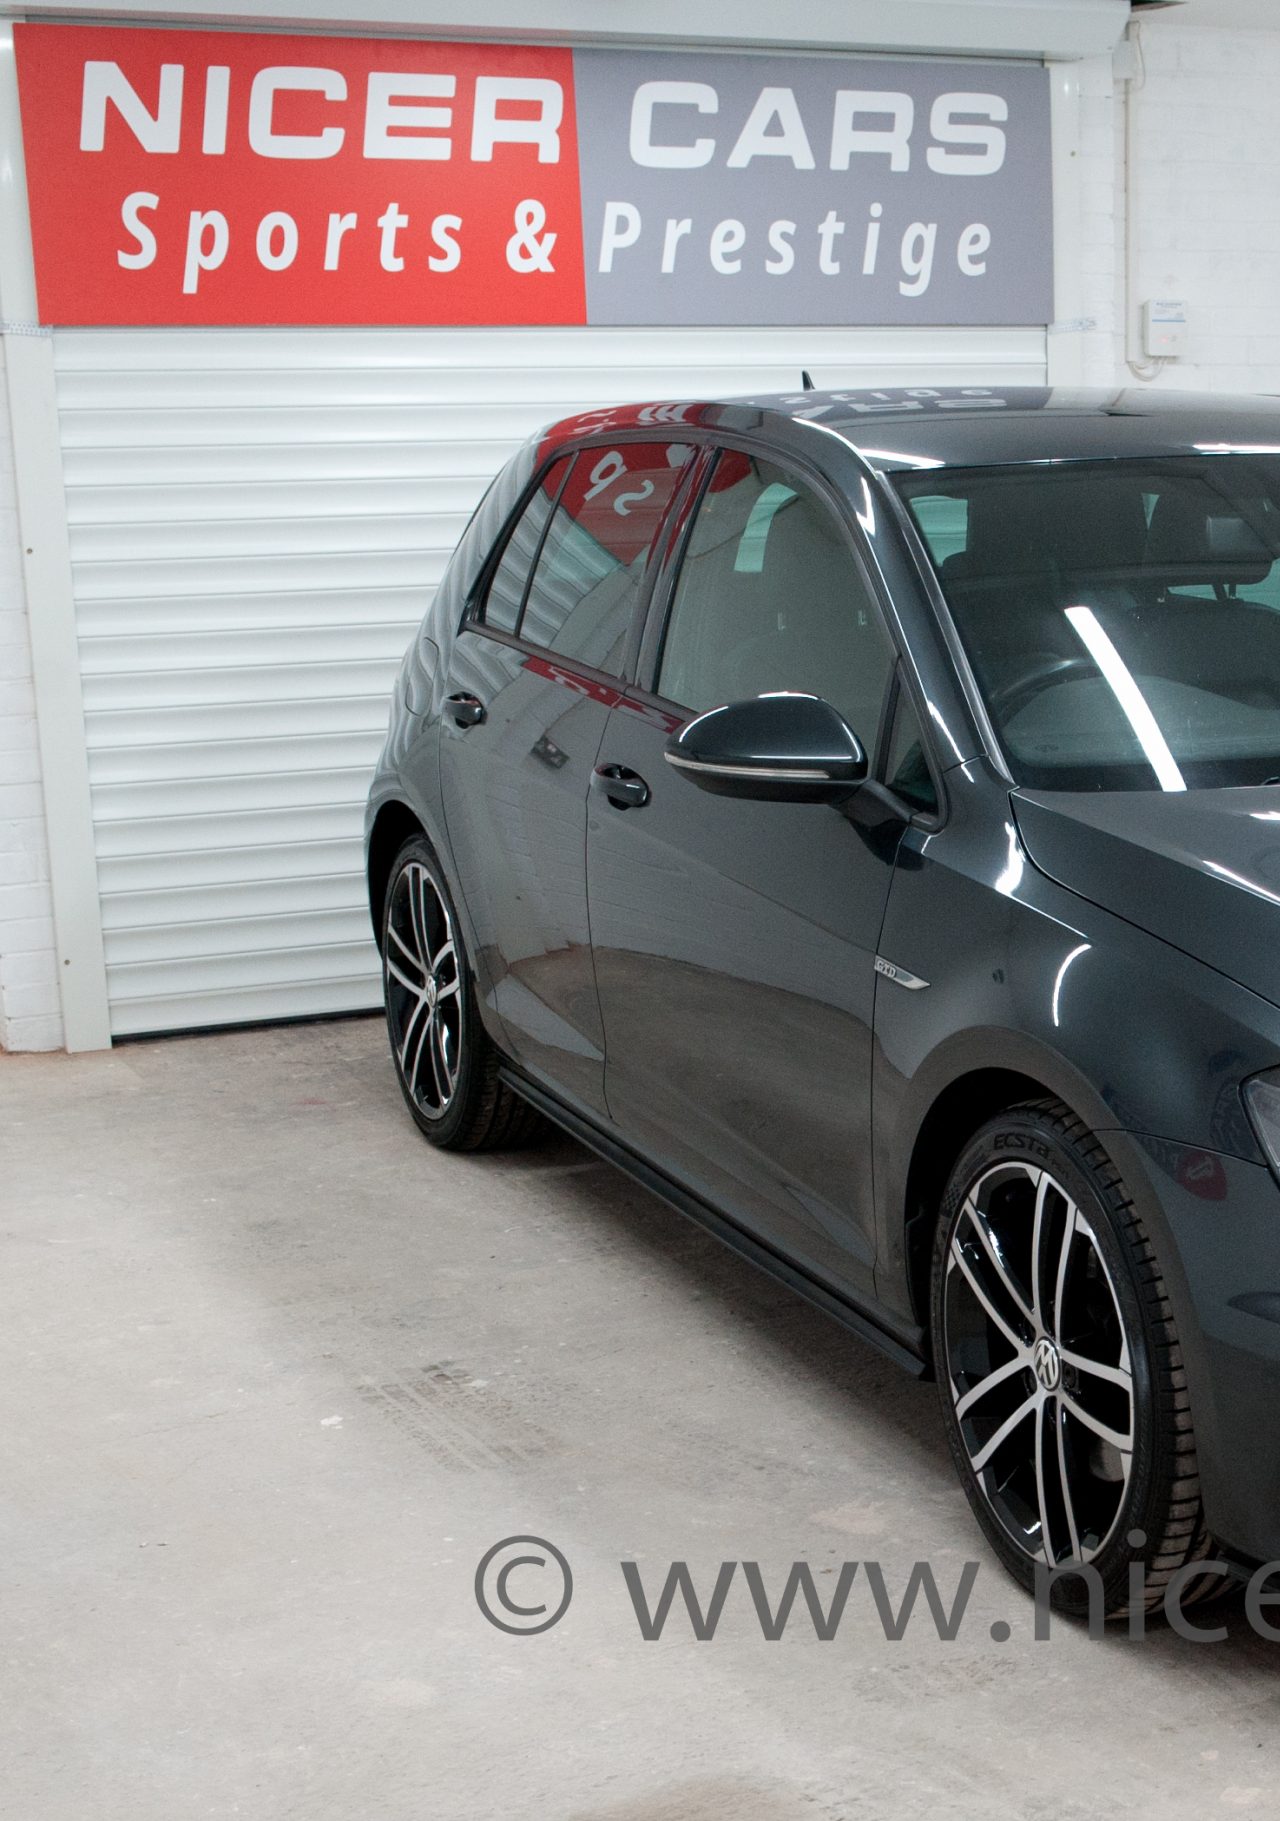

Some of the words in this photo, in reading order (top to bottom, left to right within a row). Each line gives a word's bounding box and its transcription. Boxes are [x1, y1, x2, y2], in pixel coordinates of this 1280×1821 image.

[80, 61, 563, 164] NICER
[629, 81, 1008, 176] CARS
[118, 192, 462, 294] Sports
[505, 199, 558, 273] &
[597, 200, 991, 297] Prestige
